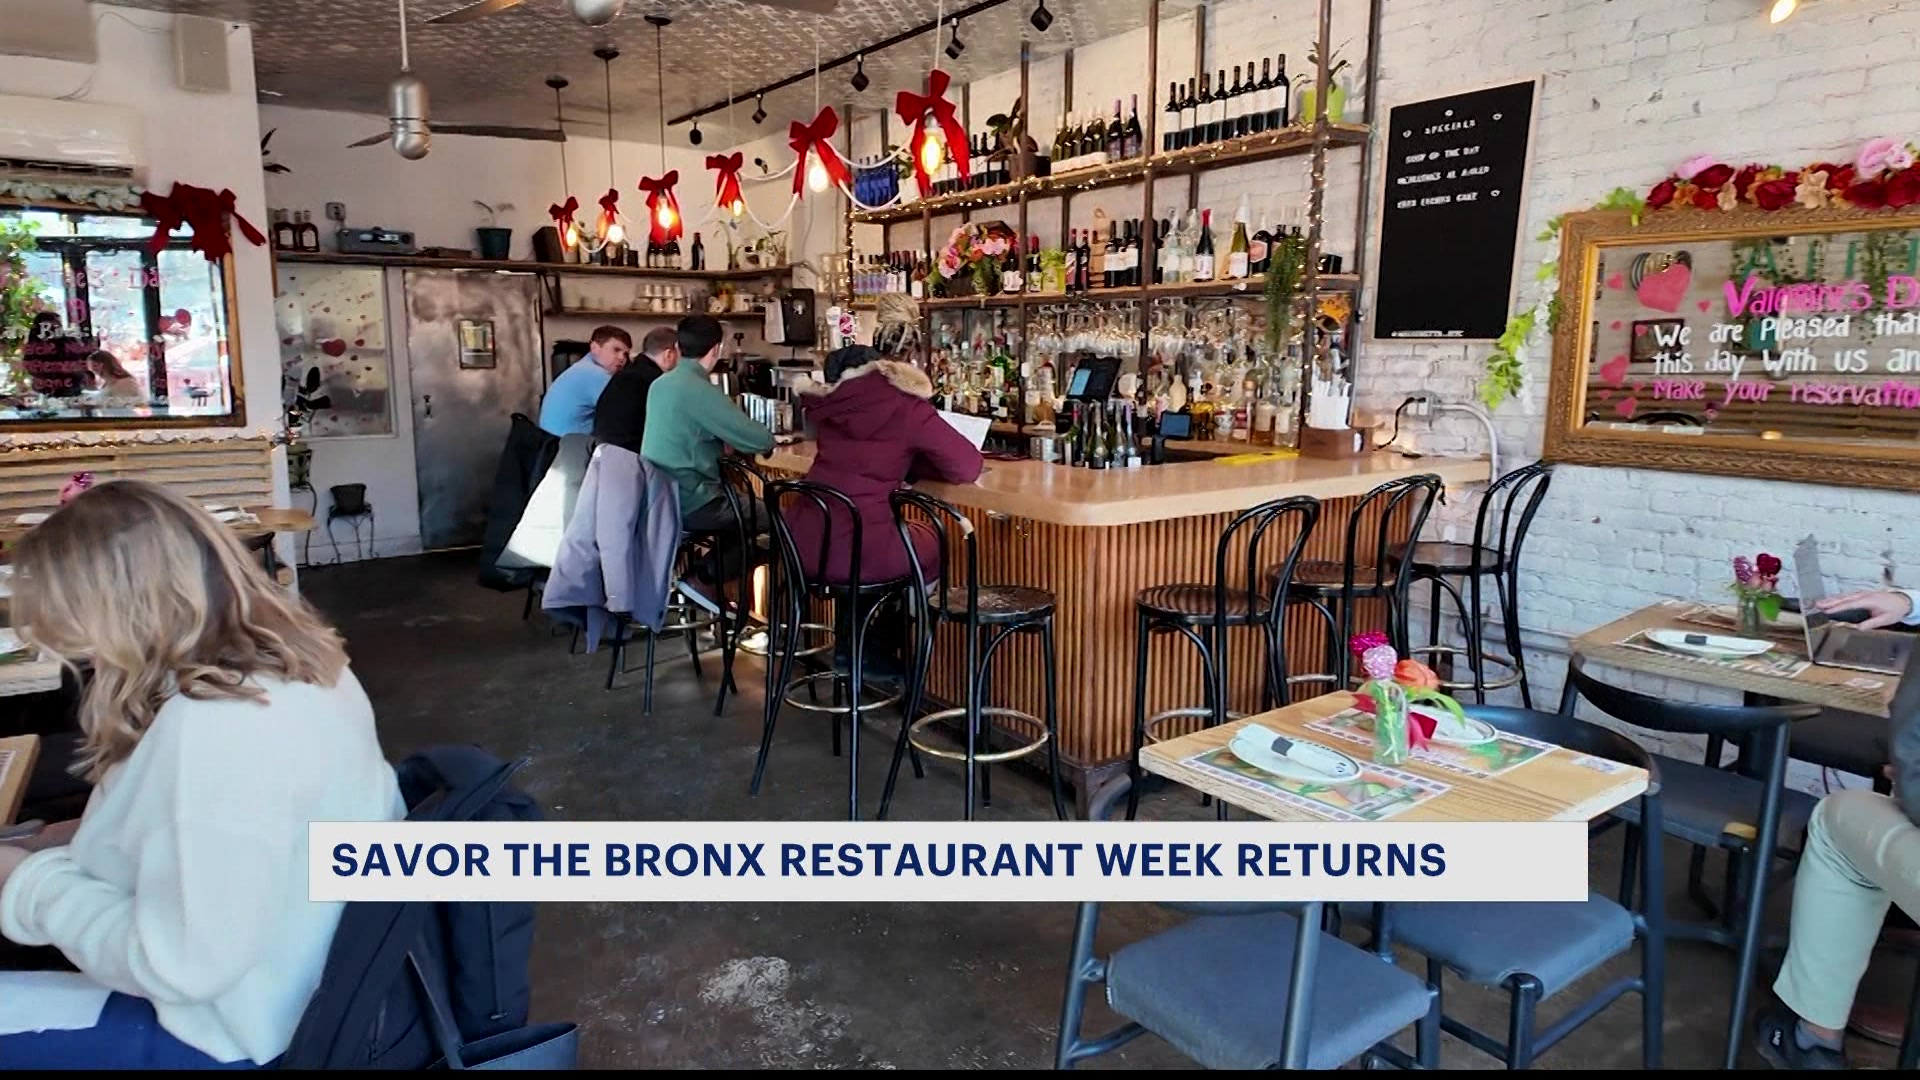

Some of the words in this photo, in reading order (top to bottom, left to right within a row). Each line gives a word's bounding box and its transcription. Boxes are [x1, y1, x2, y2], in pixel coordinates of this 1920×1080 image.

[1653, 325, 1691, 347] We
[1709, 322, 1744, 343] are
[1652, 351, 1693, 375] this
[1705, 349, 1747, 382] day
[1833, 349, 1869, 374] us
[1653, 379, 1706, 400] Make
[1723, 380, 1777, 406] your
